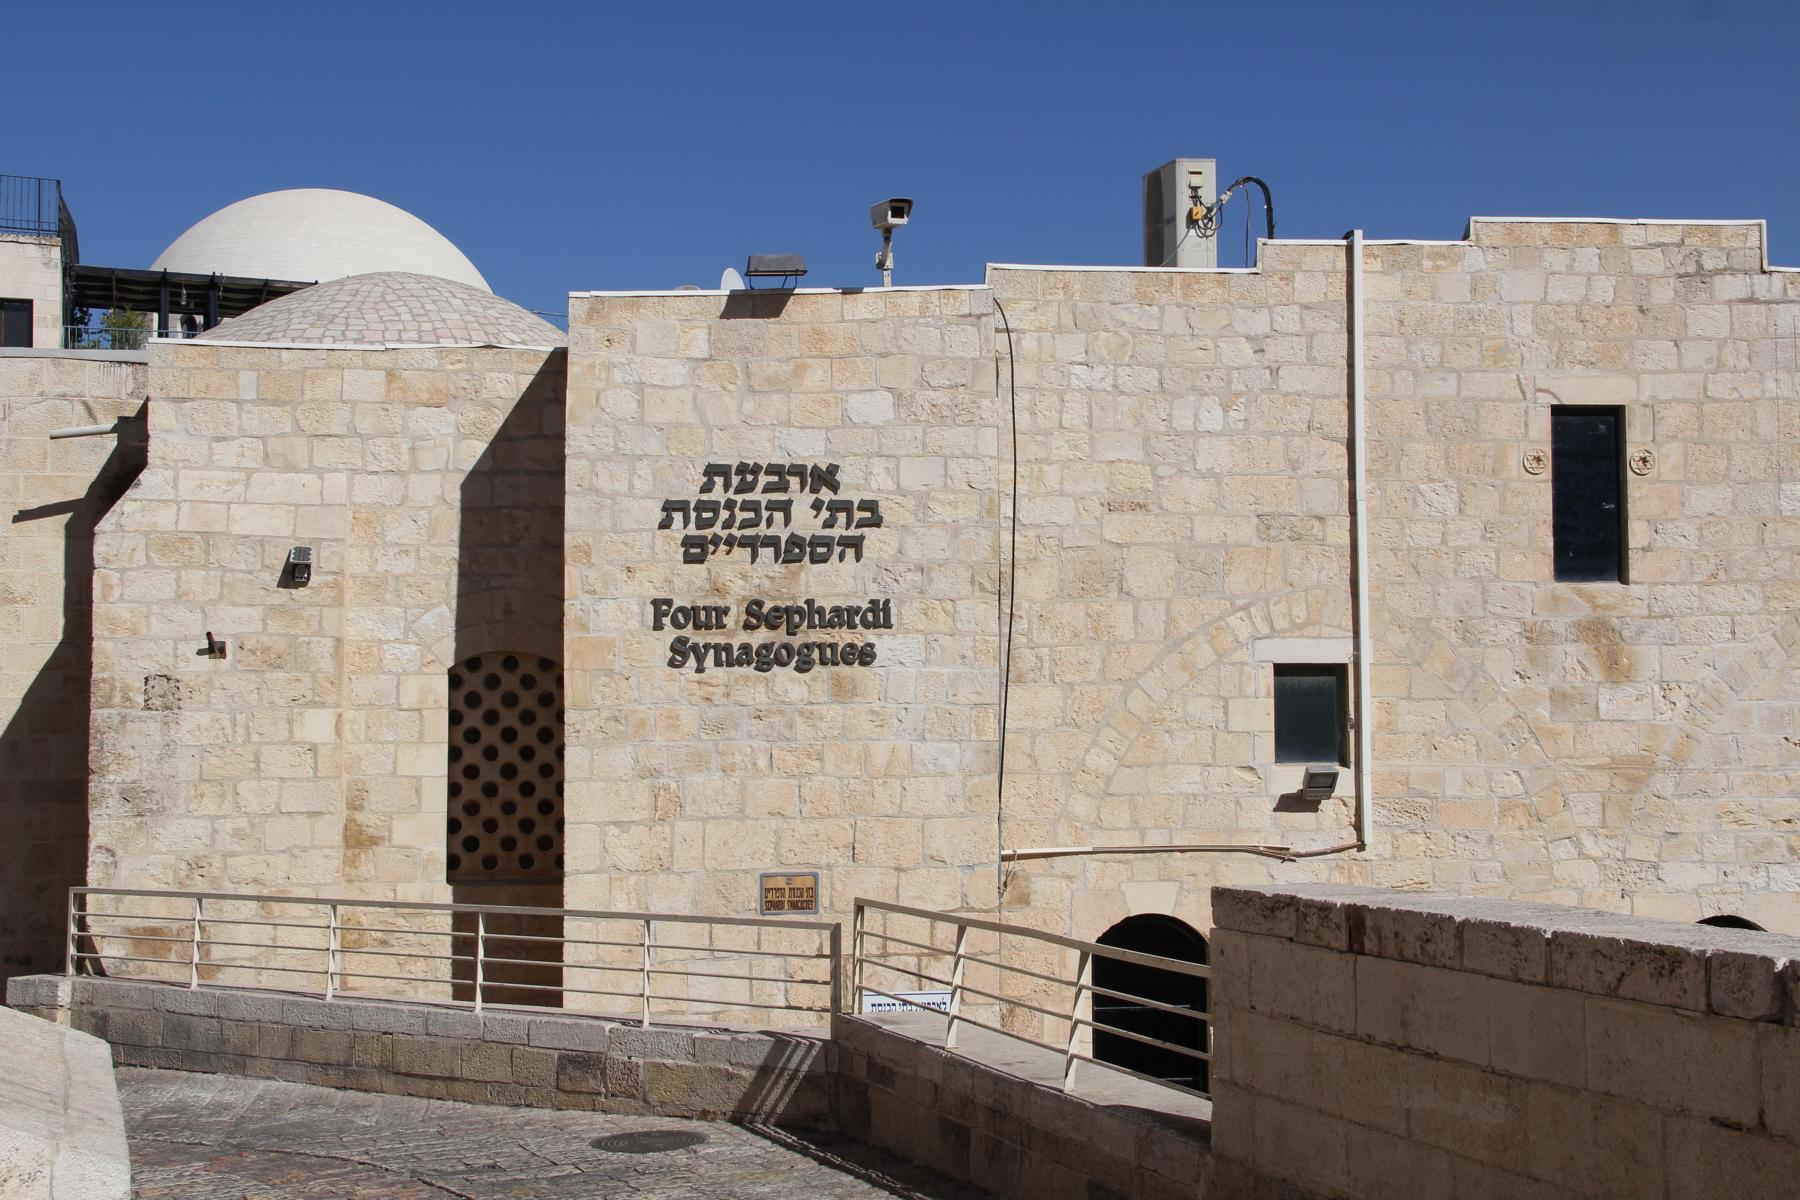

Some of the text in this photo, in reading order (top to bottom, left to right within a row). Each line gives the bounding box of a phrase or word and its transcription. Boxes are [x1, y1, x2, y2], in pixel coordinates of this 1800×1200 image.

[699, 461, 840, 495] ארבעת
[658, 497, 884, 530] בתי הכנסת
[680, 532, 866, 565] הספרדיים
[650, 598, 894, 635] Four Sephardi
[667, 635, 877, 673] Synagogues
[871, 1002, 897, 1012] הכנסת
